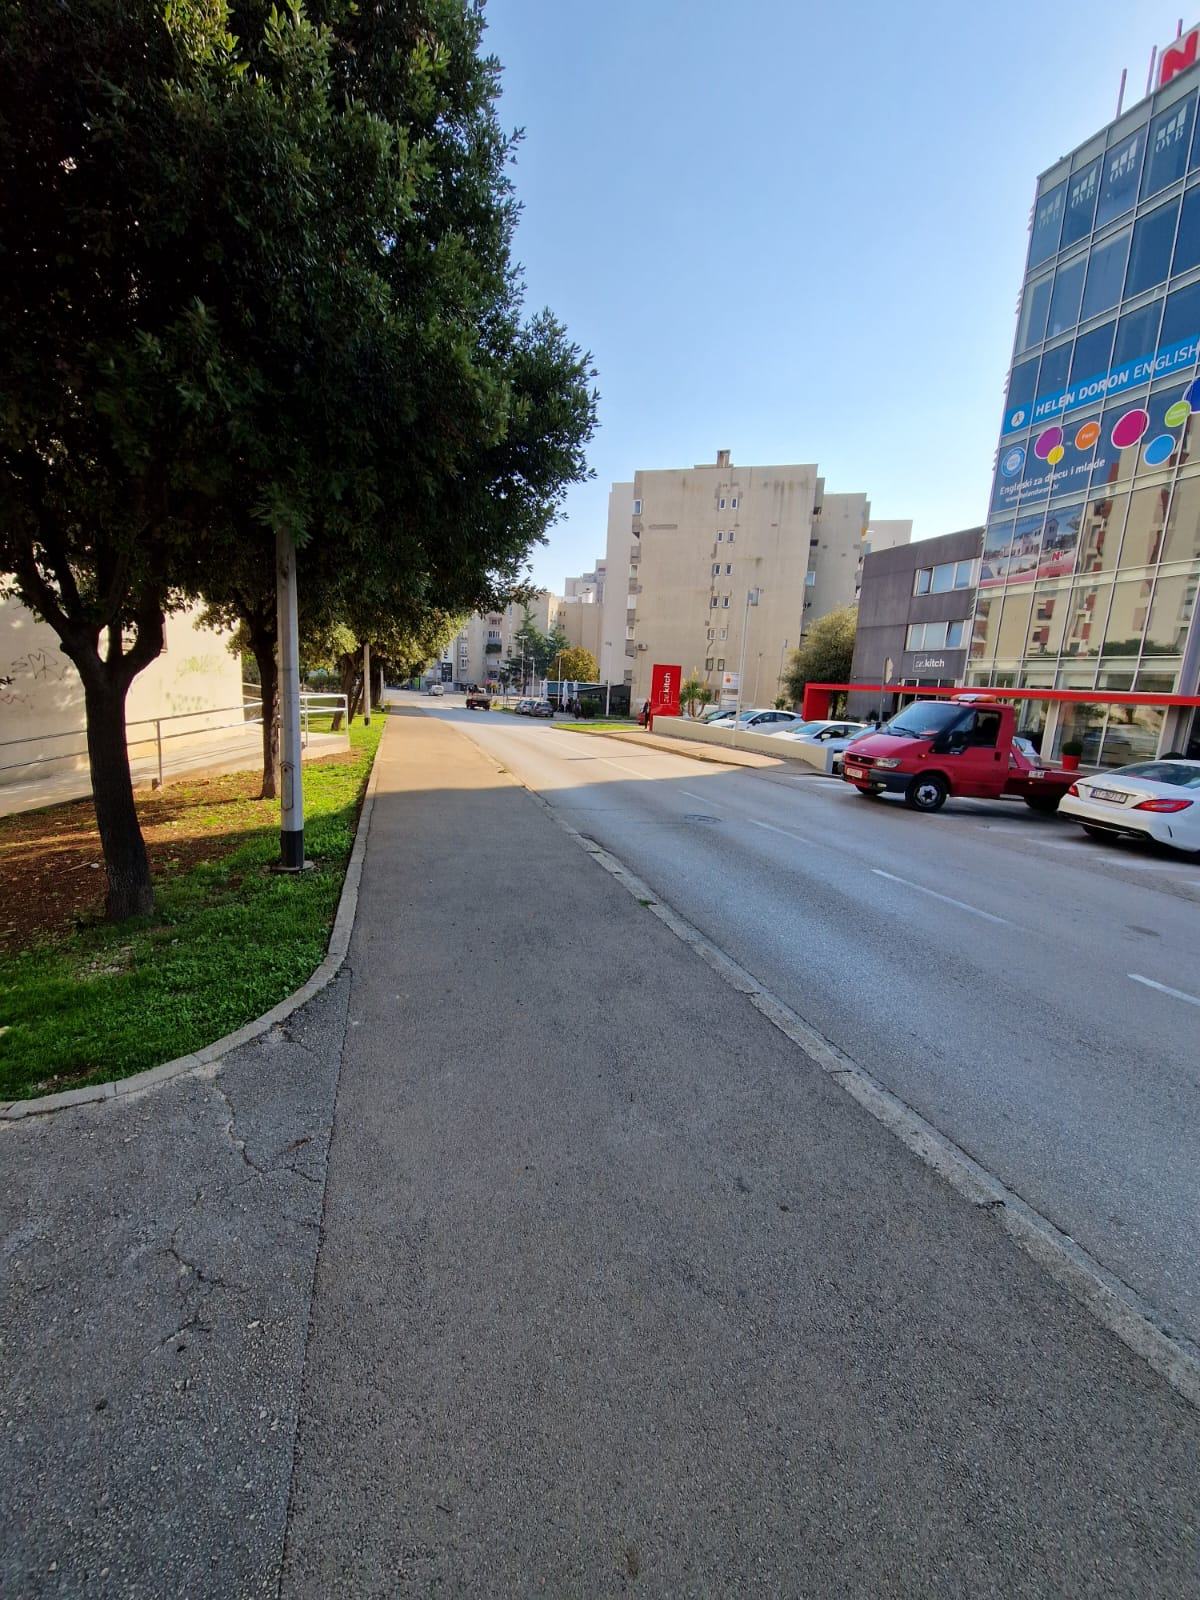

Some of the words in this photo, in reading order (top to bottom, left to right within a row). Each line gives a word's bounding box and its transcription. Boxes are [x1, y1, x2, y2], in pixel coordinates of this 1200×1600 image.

[1155, 126, 1184, 153] OVB
[1035, 391, 1075, 417] HELEN
[1078, 369, 1129, 401] DORON
[1133, 343, 1199, 379] ENGLISH
[1033, 477, 1043, 486] za
[1075, 458, 1106, 474] mlade
